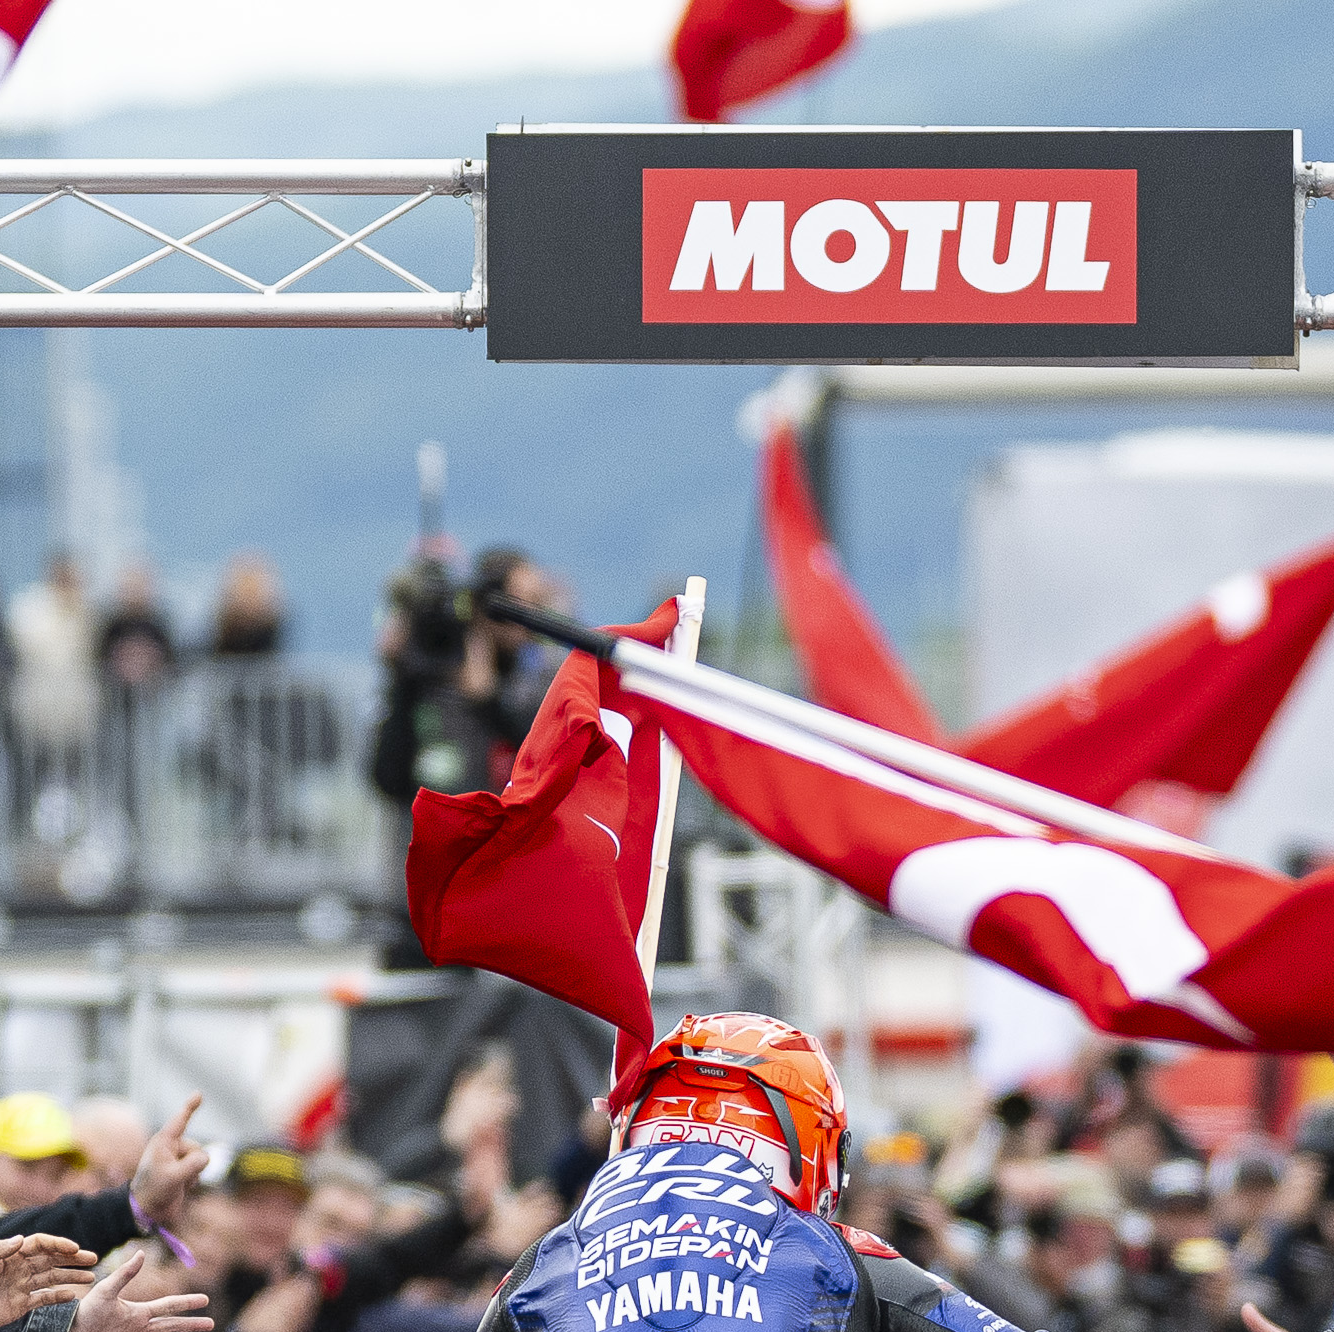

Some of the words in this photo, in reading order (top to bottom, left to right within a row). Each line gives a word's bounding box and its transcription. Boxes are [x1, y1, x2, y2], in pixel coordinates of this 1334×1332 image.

[669, 198, 1110, 293] MOTUL
[699, 1066, 725, 1077] SHOEI
[587, 1147, 765, 1194] BLU
[580, 1177, 777, 1230] CRU
[577, 1252, 614, 1289] DI
[620, 1236, 769, 1274] DEPAN
[585, 1270, 763, 1332] YAMAHA
